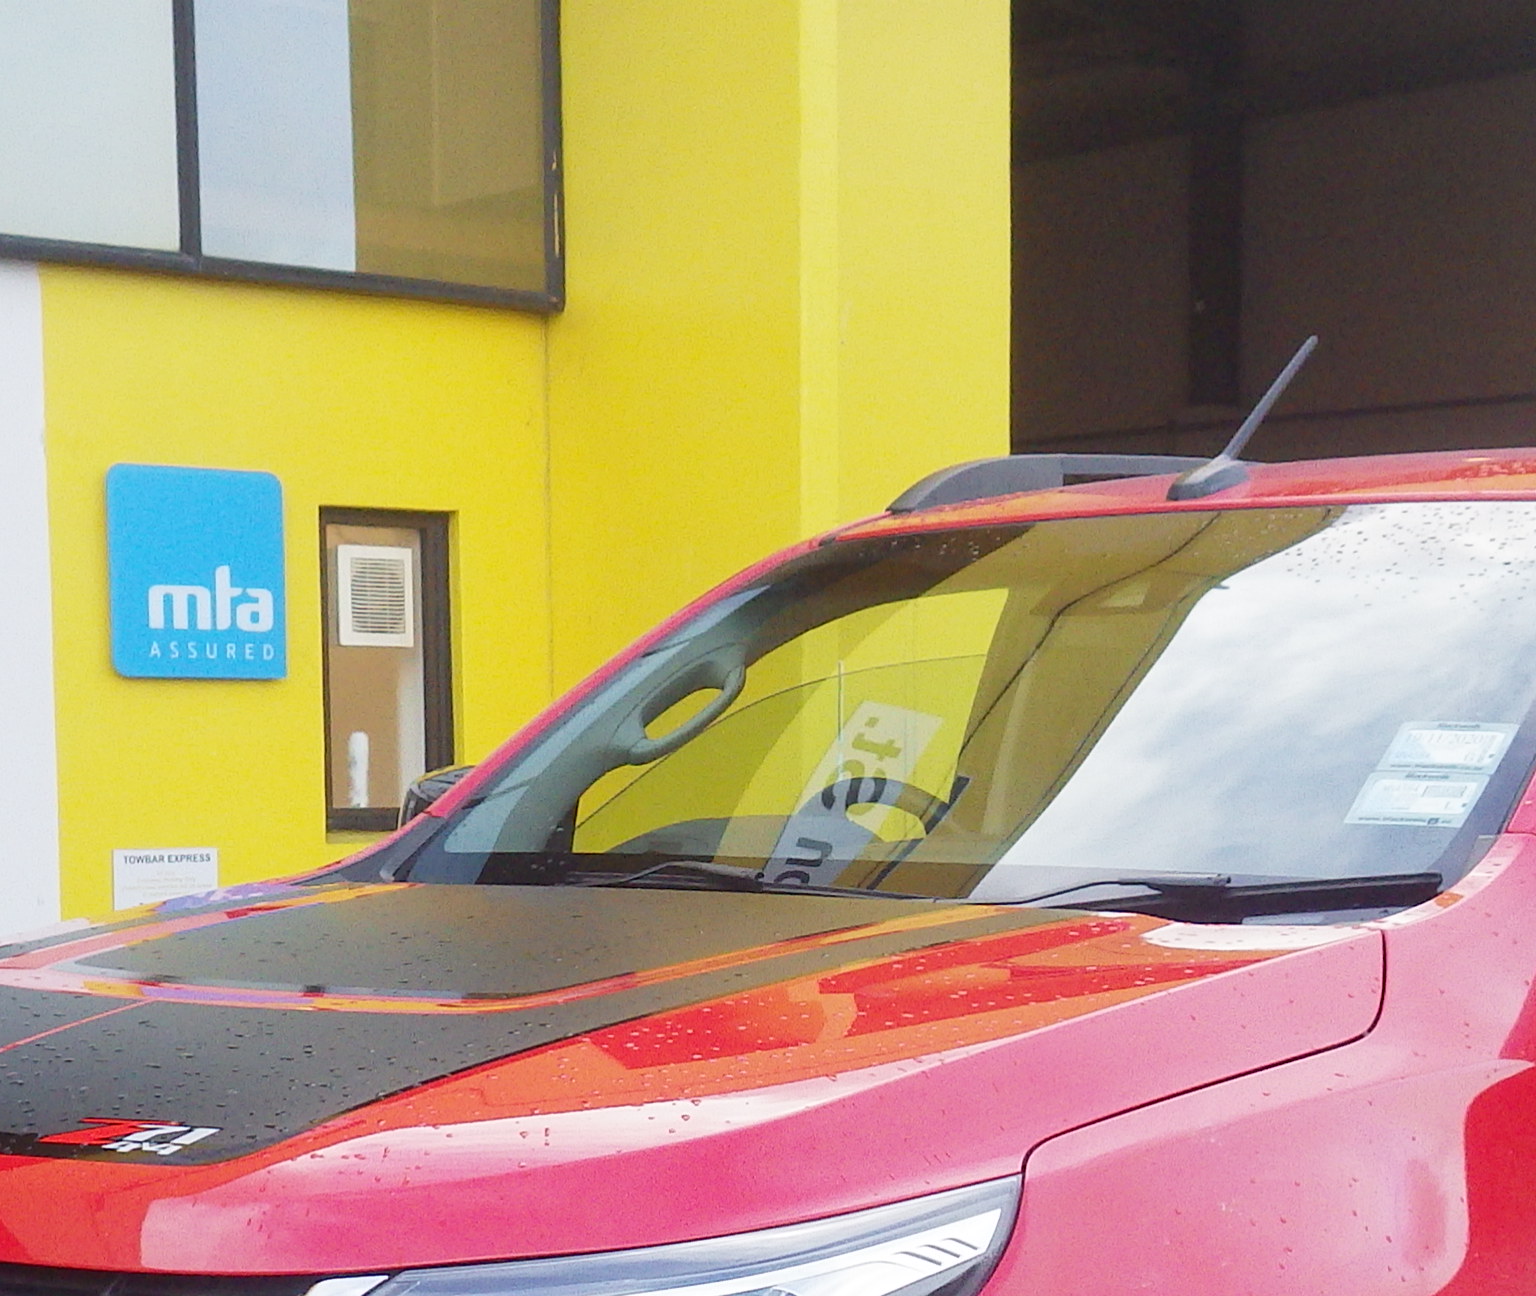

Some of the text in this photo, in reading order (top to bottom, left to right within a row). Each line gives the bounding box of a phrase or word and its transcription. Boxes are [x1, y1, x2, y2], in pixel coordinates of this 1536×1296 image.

[149, 565, 273, 632] mta
[149, 641, 275, 660] ASSURED
[123, 853, 211, 864] TOWBAR EXPRESS
